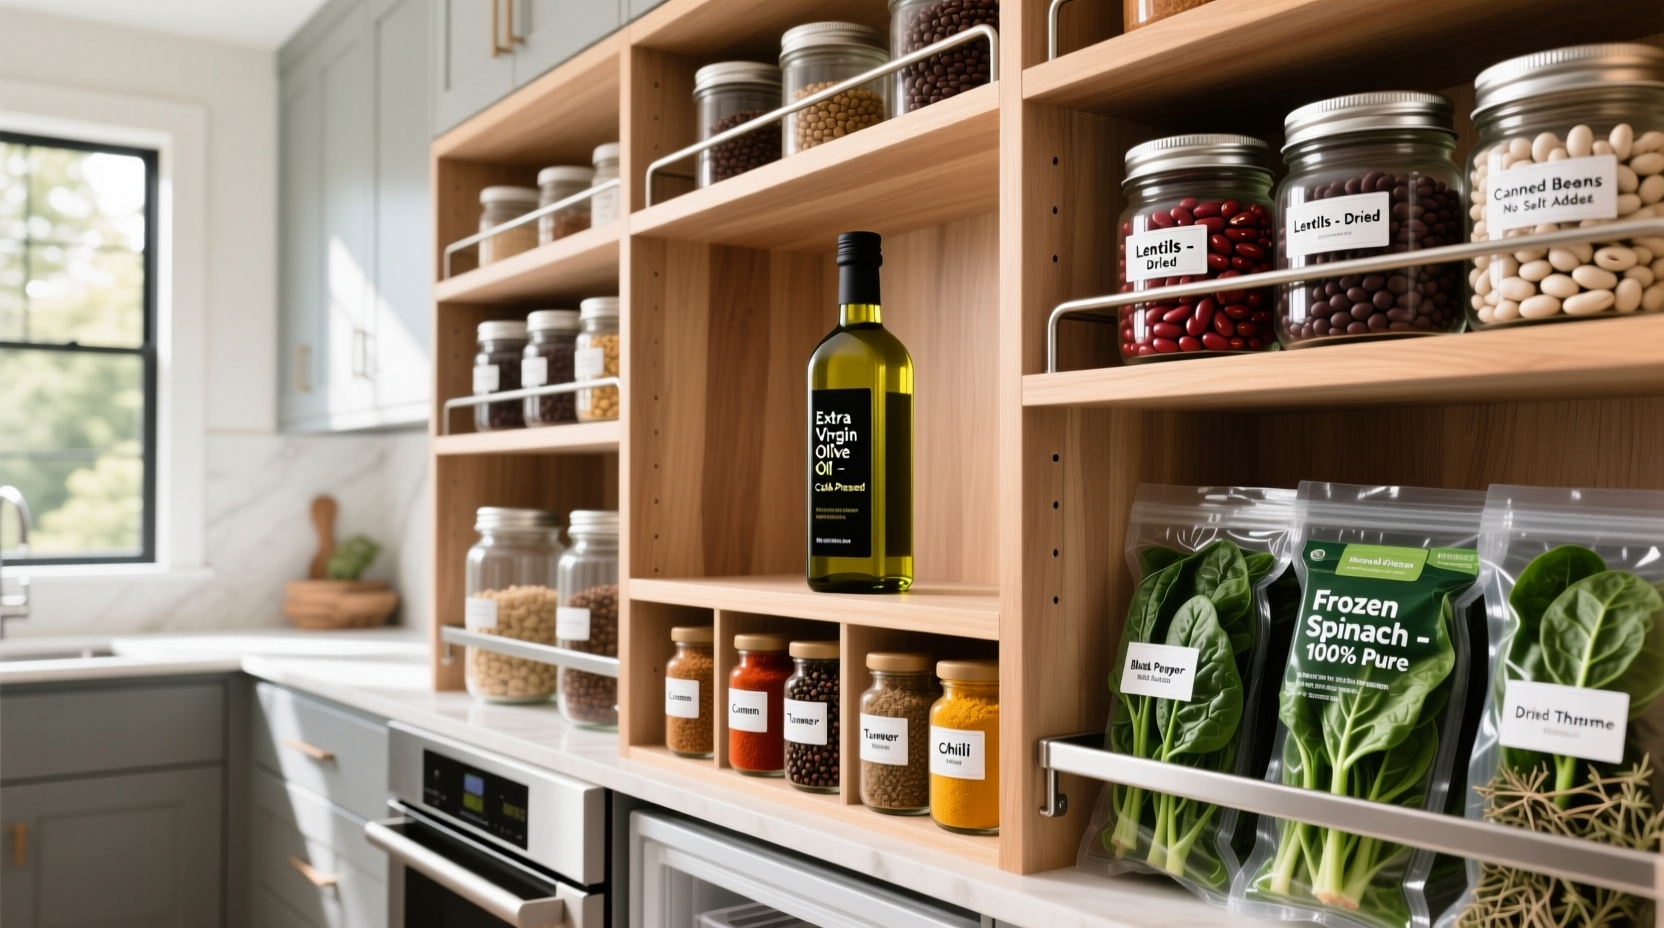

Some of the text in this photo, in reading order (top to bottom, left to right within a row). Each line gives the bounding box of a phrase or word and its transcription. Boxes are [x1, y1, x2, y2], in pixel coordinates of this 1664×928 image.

[1494, 176, 1603, 201] Canned Beans
[1345, 208, 1380, 225] Dried
[1136, 239, 1181, 258] Lentils
[816, 411, 851, 425] Extra
[815, 444, 850, 459] Olive
[1312, 589, 1398, 618] Frozen
[1305, 614, 1408, 647] Spinach
[1306, 643, 1409, 672] 100% Pure
[1515, 705, 1549, 721] Dried
